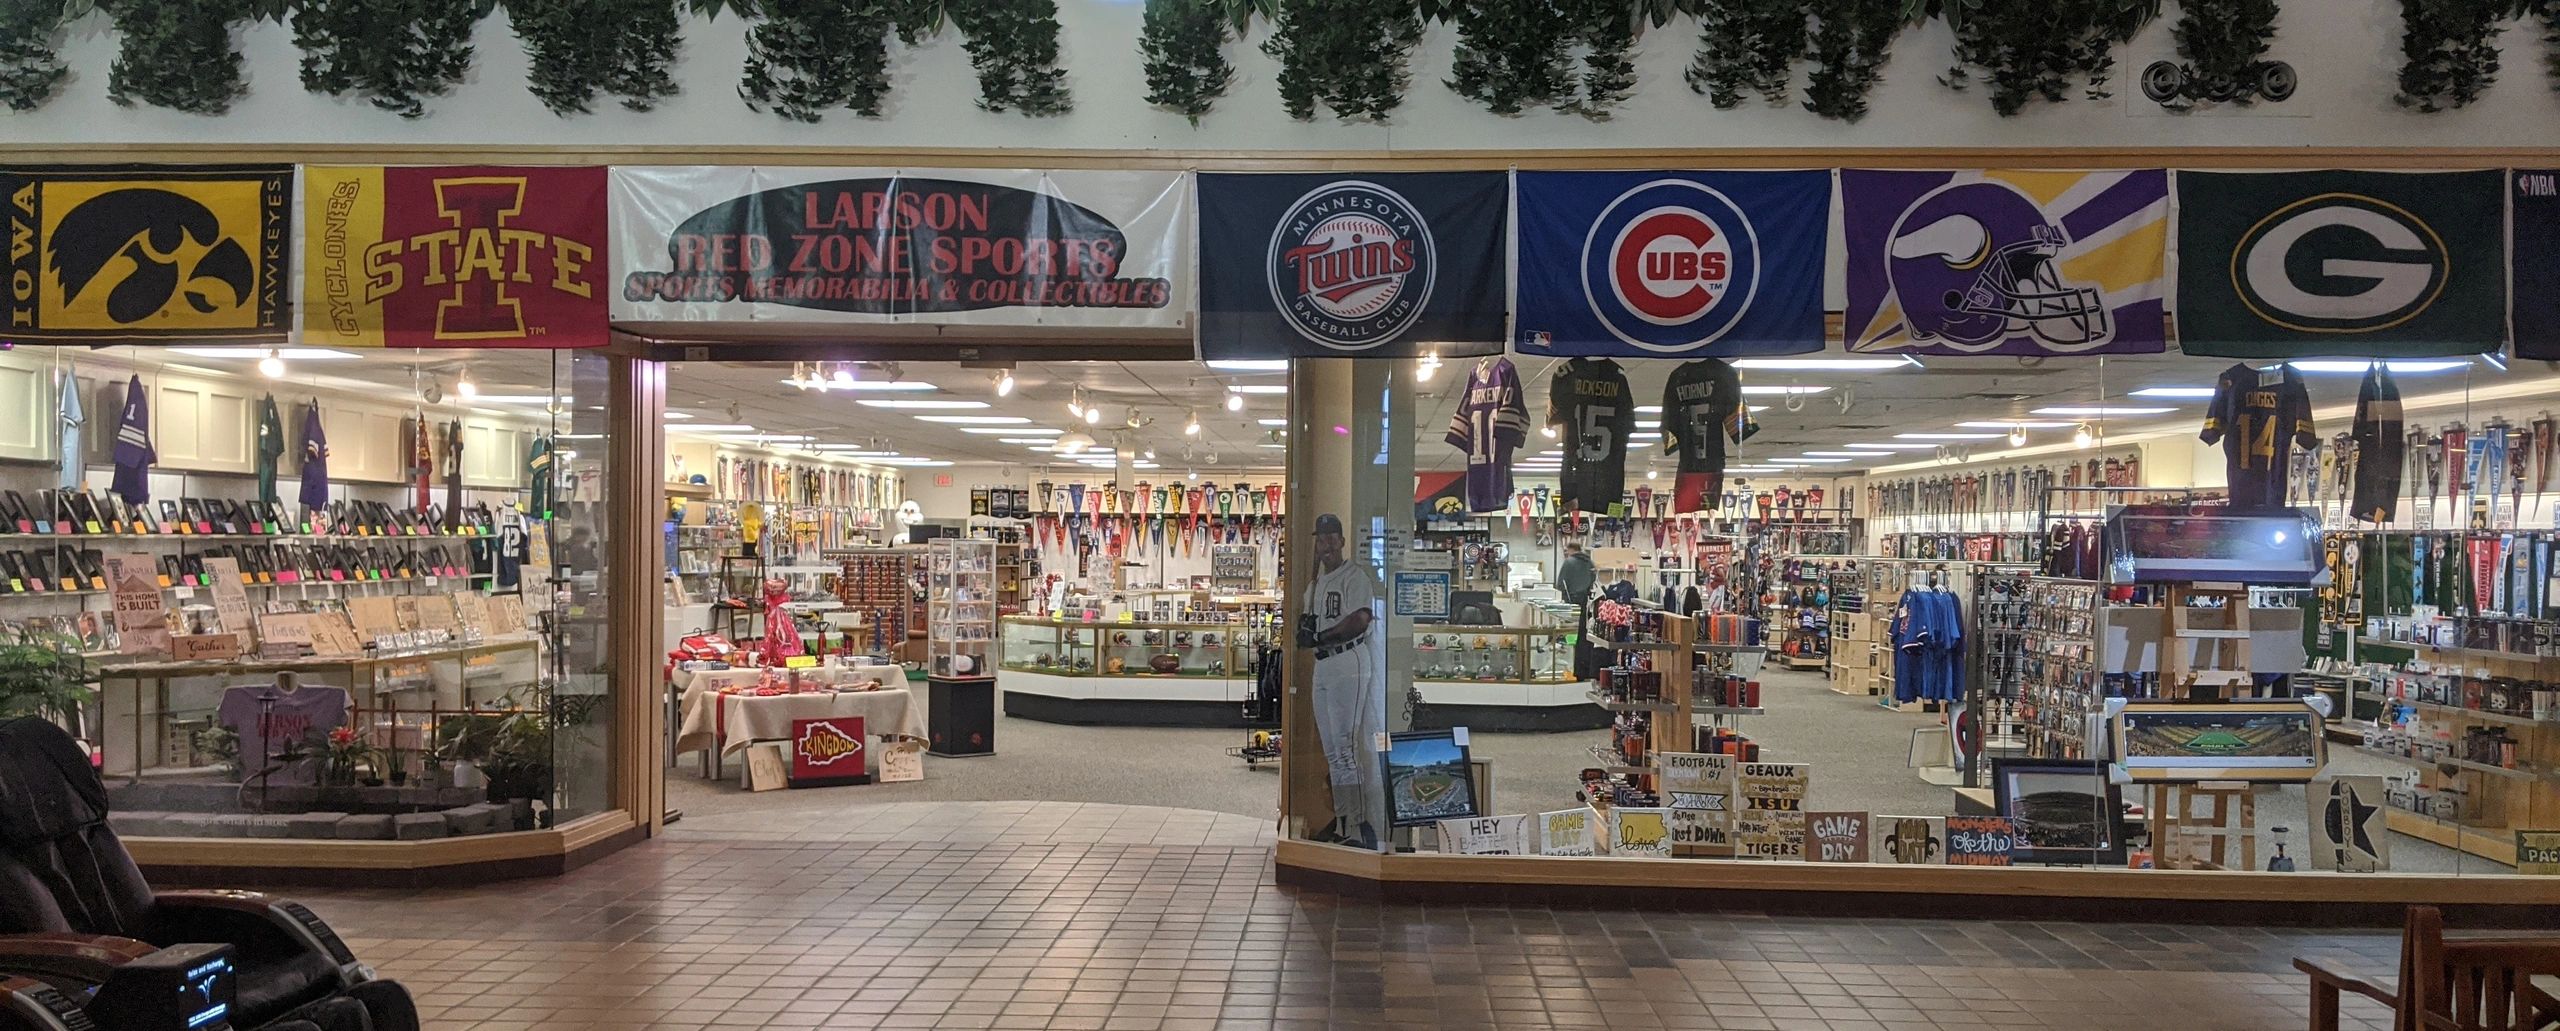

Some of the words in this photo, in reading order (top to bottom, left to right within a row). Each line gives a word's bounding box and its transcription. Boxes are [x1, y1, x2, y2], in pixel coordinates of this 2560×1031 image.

[2530, 175, 2557, 196] NBA
[805, 191, 989, 231] LARSON
[1292, 196, 1413, 238] MINNESOTA
[12, 181, 36, 327] IOWA
[262, 179, 282, 327] HAWKEYES
[324, 179, 360, 337] CYCLONES
[678, 234, 772, 272] RED
[788, 234, 912, 273] ZONE
[930, 236, 1116, 277] SPORTS
[364, 228, 592, 304] STATE
[1284, 233, 1416, 300] Twins
[624, 274, 735, 301] SPORTS
[743, 276, 933, 301] MEMORABILIA
[941, 278, 961, 301] &
[967, 278, 1170, 306] COLLECTIBLES
[1294, 300, 1370, 337] BASEBALL
[1375, 298, 1411, 331] CLUB
[1575, 379, 1620, 397] ACKSON
[1574, 403, 1616, 463] 15
[2236, 413, 2277, 472] 14
[503, 527, 520, 557] 82
[116, 601, 127, 611] IS
[129, 600, 161, 611] BUILT
[1325, 591, 1341, 619] D
[806, 731, 855, 756] KINGDOM
[1671, 756, 1726, 769] FOOTBALL
[1745, 765, 1794, 777] GEAUX
[1754, 798, 1791, 810] LSU
[1549, 812, 1585, 831] GAME
[1672, 810, 1695, 821] fense
[1946, 818, 2012, 834] MONSTERS
[2340, 782, 2353, 862] COWBOYS
[1470, 819, 1500, 835] HEY
[1672, 825, 1691, 842] irst
[1813, 816, 1861, 838] GAME
[1746, 843, 1799, 855] TIGERS
[1821, 843, 1855, 860] DAY
[1952, 831, 1976, 853] of
[1975, 832, 2011, 852] the
[1950, 853, 2010, 865] MIDWAY
[2528, 849, 2560, 863] PAC
